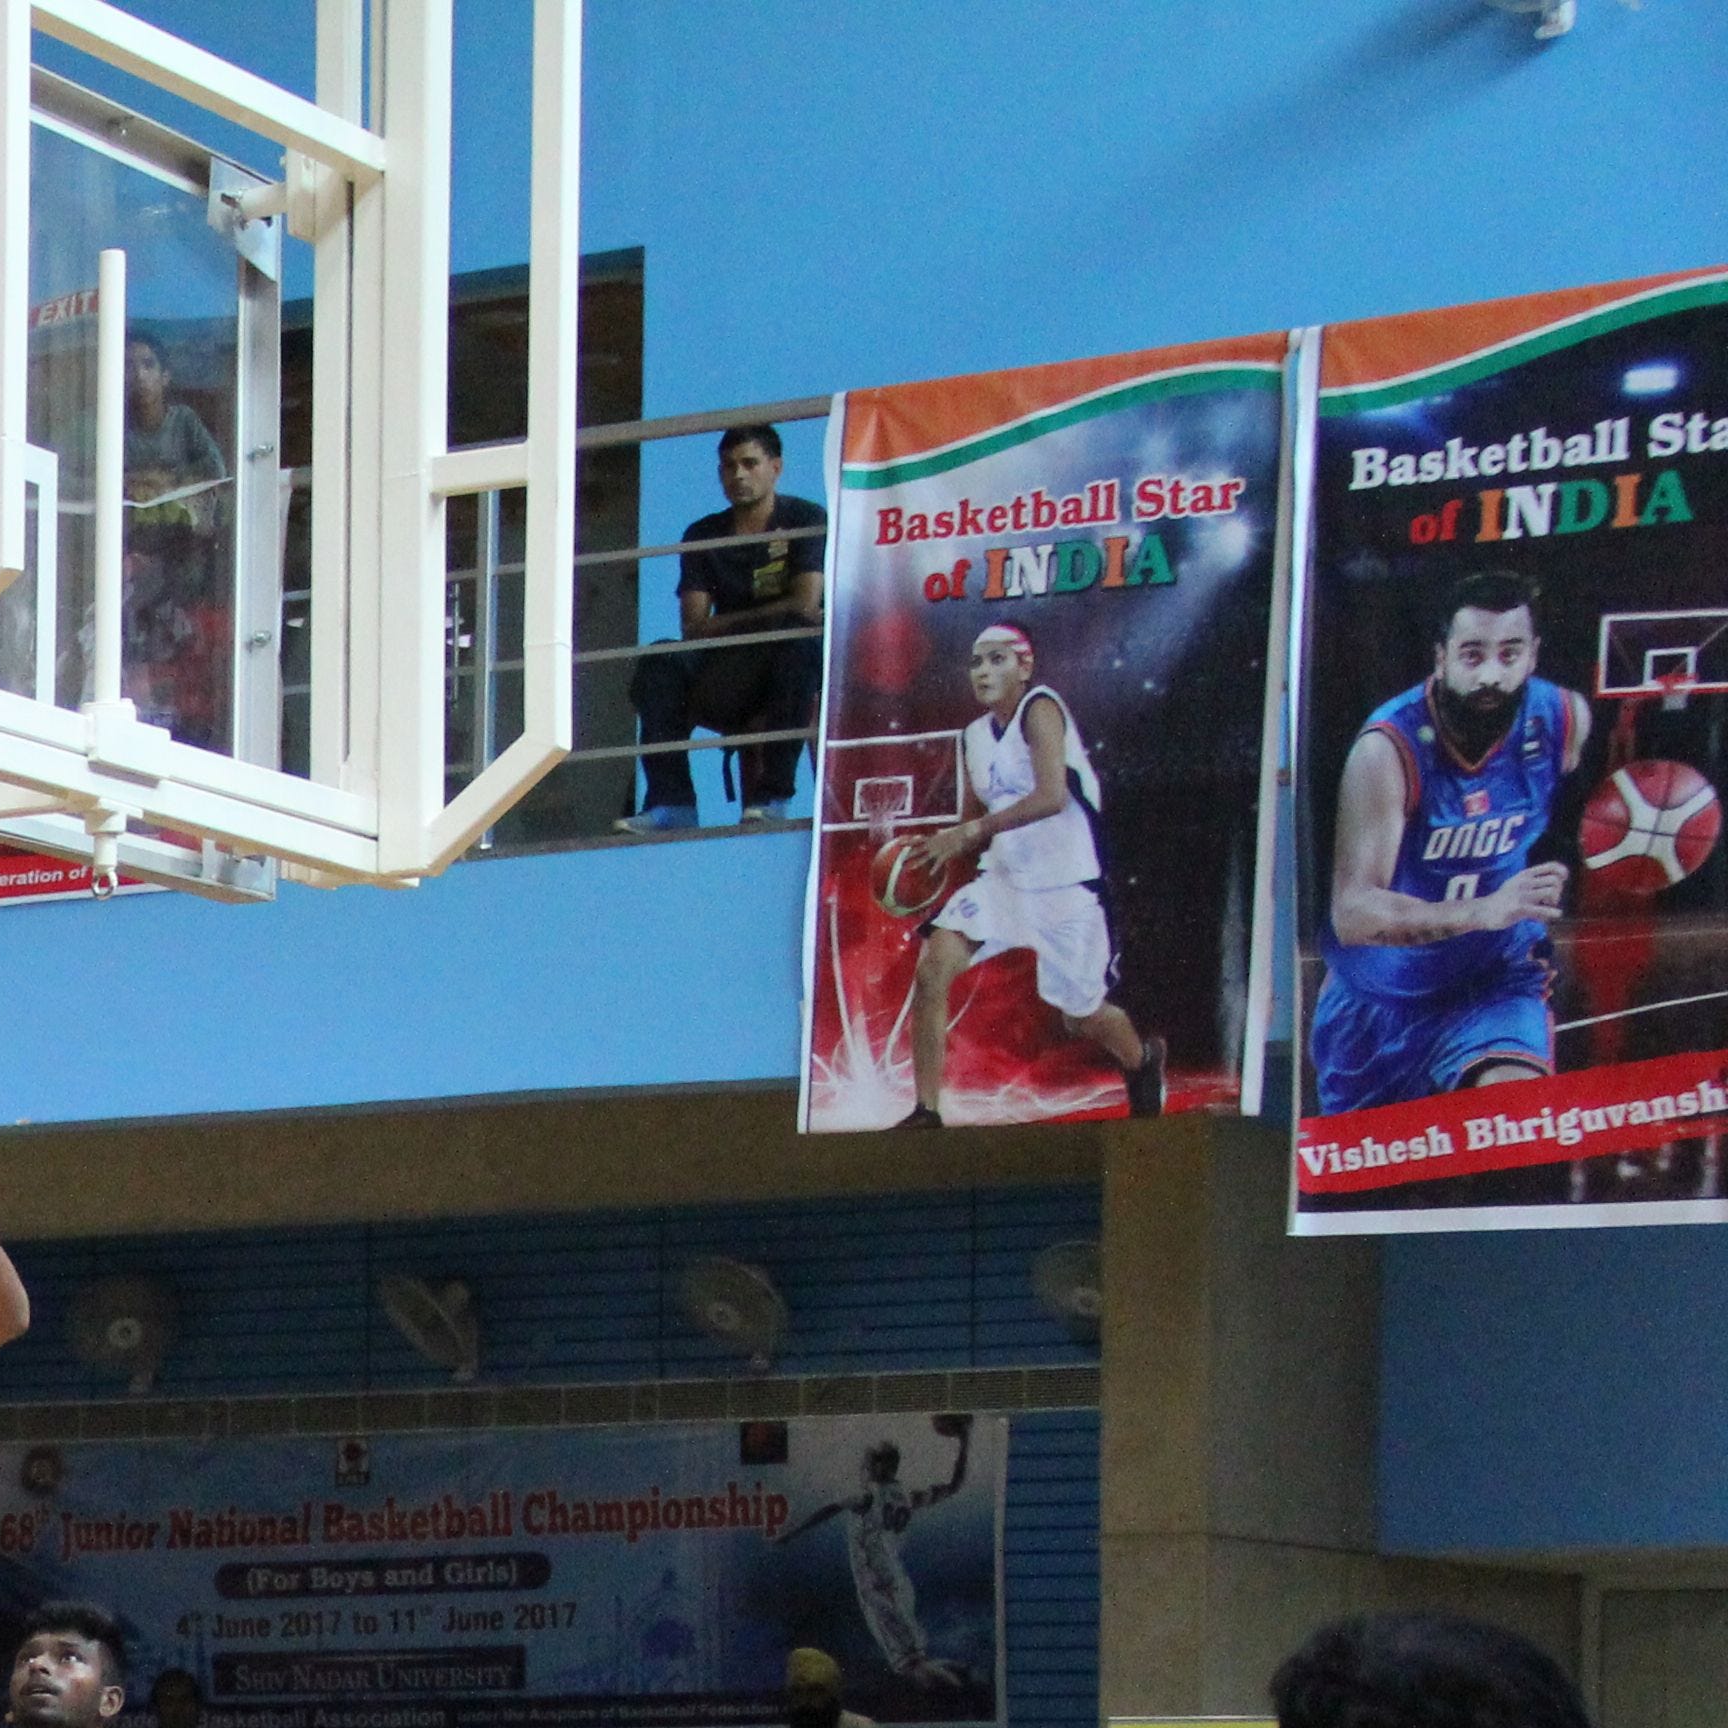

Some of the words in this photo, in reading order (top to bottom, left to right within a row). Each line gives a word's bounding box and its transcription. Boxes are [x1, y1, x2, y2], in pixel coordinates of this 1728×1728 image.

[1350, 418, 1628, 490] Basketball
[1647, 411, 1728, 459] Sta
[874, 479, 1116, 549] Basketball
[1135, 475, 1245, 520] Star
[1411, 497, 1458, 544] of
[1477, 468, 1694, 544] INDIA
[924, 558, 971, 602] of
[983, 530, 1176, 599] INDIA
[68, 865, 88, 882] of
[1299, 1128, 1452, 1177] Vishesh
[1465, 1080, 1728, 1153] Bhriguvansh
[60, 1507, 161, 1562] Junior
[168, 1500, 312, 1551] National
[322, 1490, 513, 1544] Basketball
[522, 1482, 789, 1543] Championship
[246, 1566, 301, 1594] (For
[309, 1565, 376, 1594] Boys
[384, 1562, 434, 1587] and
[443, 1560, 518, 1586] Girls)
[211, 1613, 272, 1640] June
[280, 1610, 342, 1639] 2017
[352, 1610, 379, 1636] to
[441, 1605, 504, 1634] June
[512, 1602, 578, 1632] 2017
